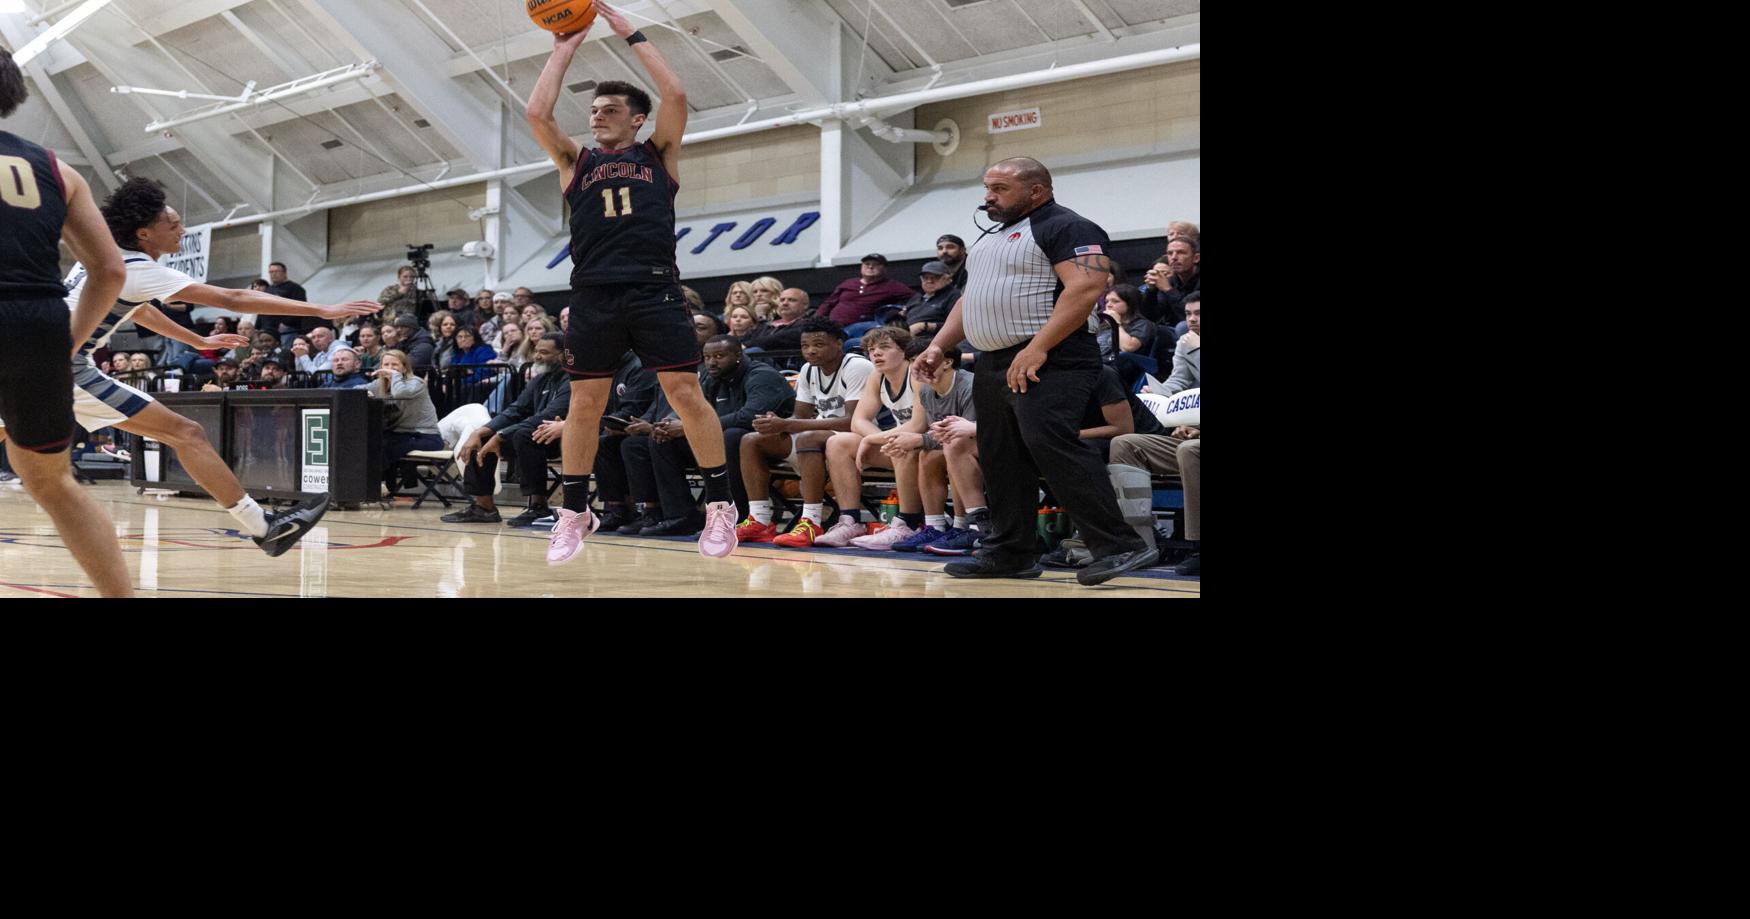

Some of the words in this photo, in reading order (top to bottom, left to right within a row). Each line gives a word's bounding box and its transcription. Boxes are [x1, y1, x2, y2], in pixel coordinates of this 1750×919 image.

[542, 8, 574, 25] NCAA
[1003, 111, 1038, 128] SMOKING
[581, 161, 653, 192] LINCOLN
[601, 186, 633, 218] 11
